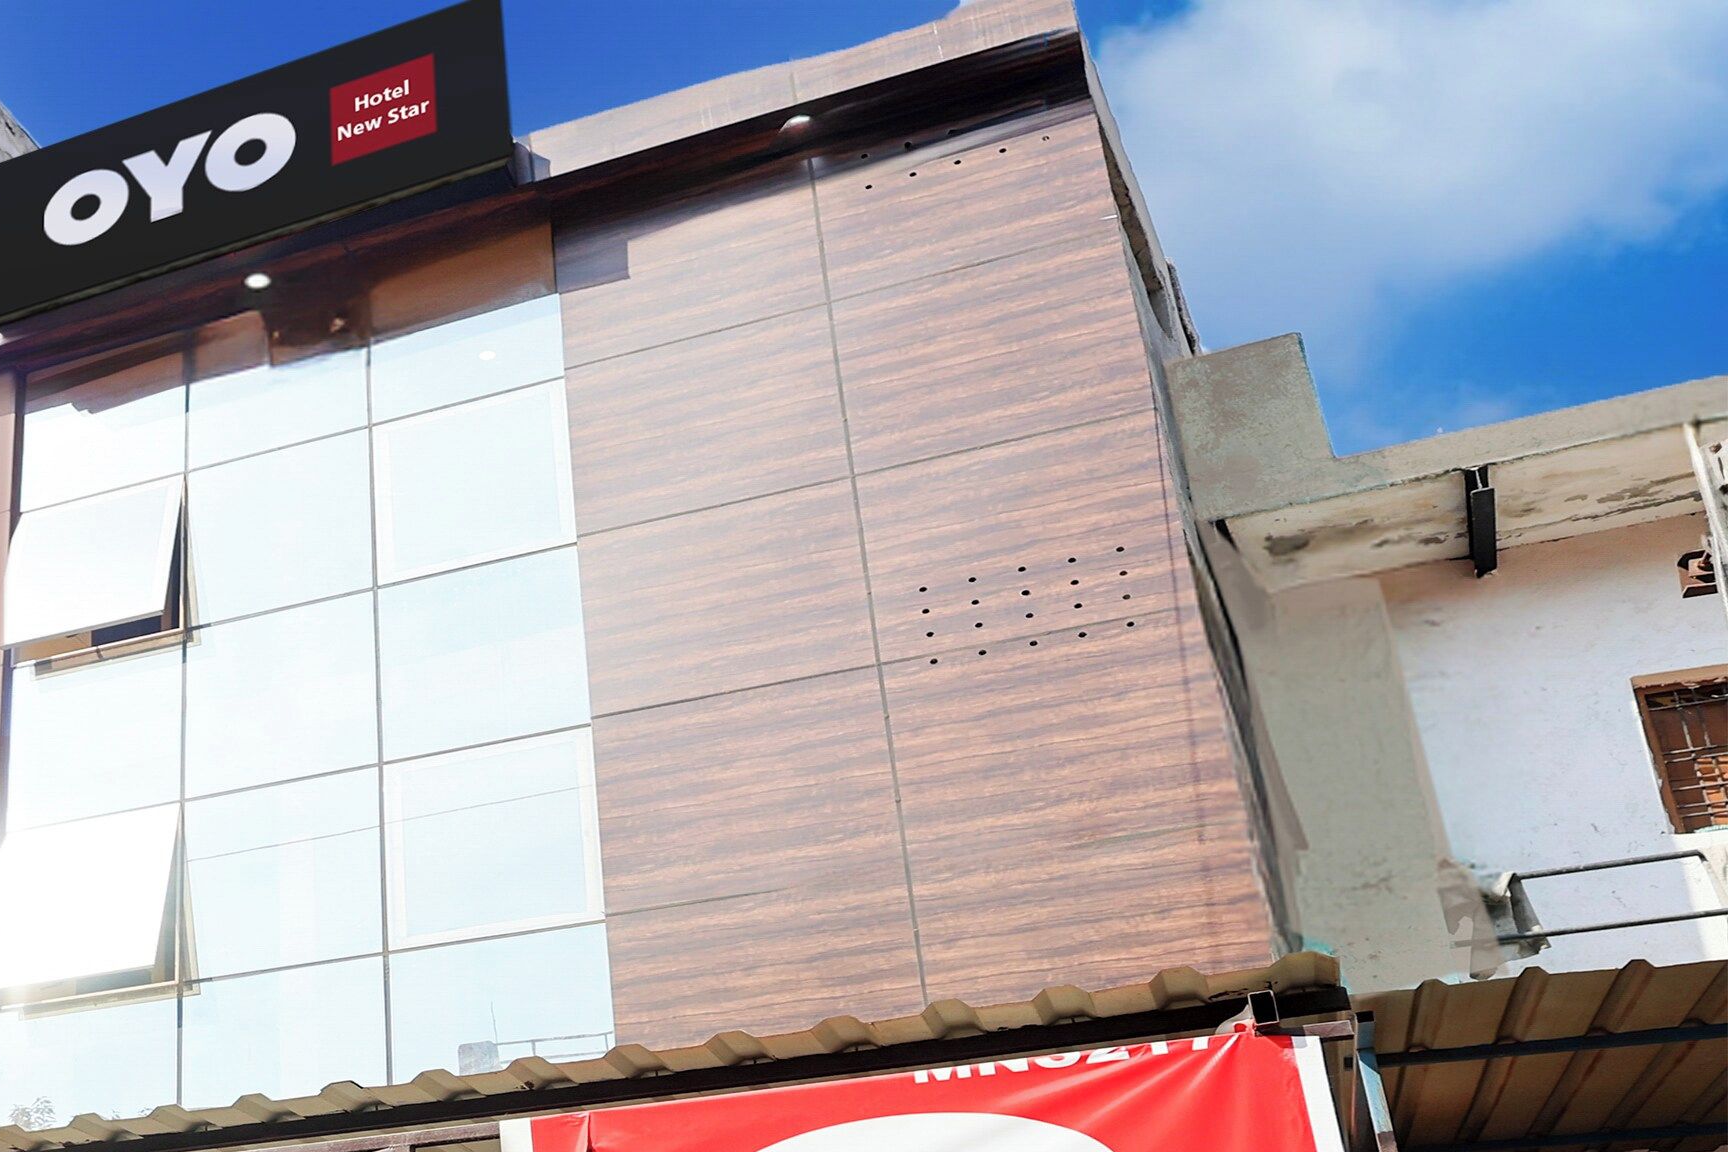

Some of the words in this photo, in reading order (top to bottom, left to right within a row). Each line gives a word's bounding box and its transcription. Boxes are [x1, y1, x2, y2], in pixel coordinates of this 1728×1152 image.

[354, 79, 410, 112] Hotel
[337, 116, 383, 141] New
[387, 100, 430, 124] Star
[44, 112, 296, 246] OYO
